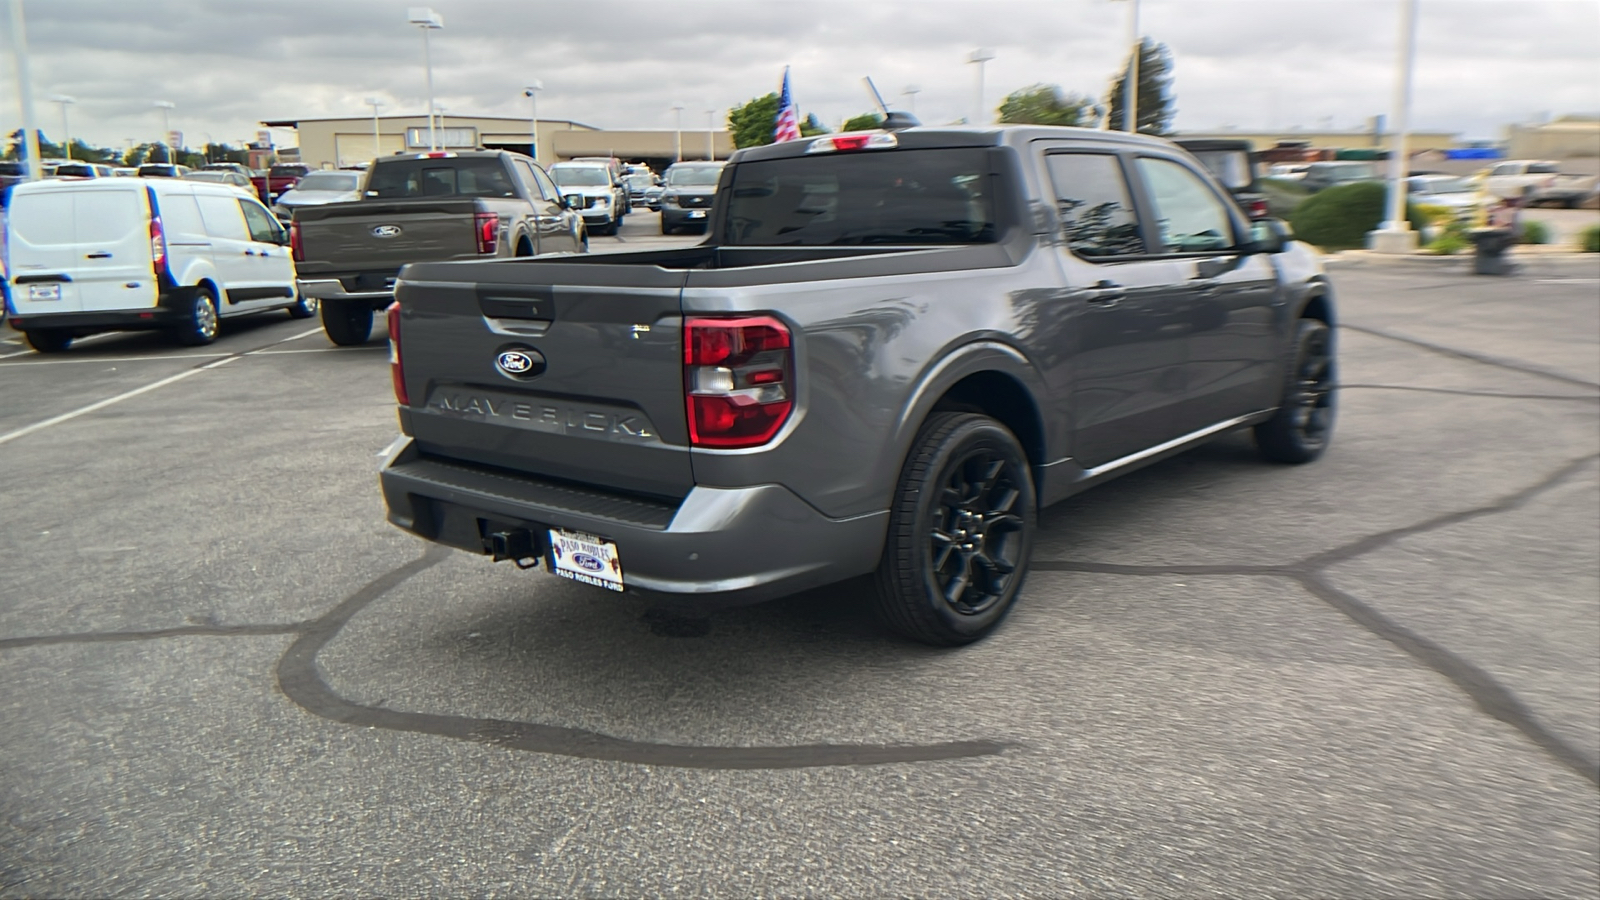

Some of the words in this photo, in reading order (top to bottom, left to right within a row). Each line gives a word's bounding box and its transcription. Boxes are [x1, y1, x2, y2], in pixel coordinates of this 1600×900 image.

[503, 354, 525, 370] Ford
[439, 397, 637, 436] MAVERICK
[560, 538, 580, 553] PASO
[581, 543, 609, 561] ROBLES
[579, 556, 599, 570] Ford
[556, 568, 574, 580] PASO
[575, 573, 603, 587] ROBLES
[603, 581, 624, 592] FORD
